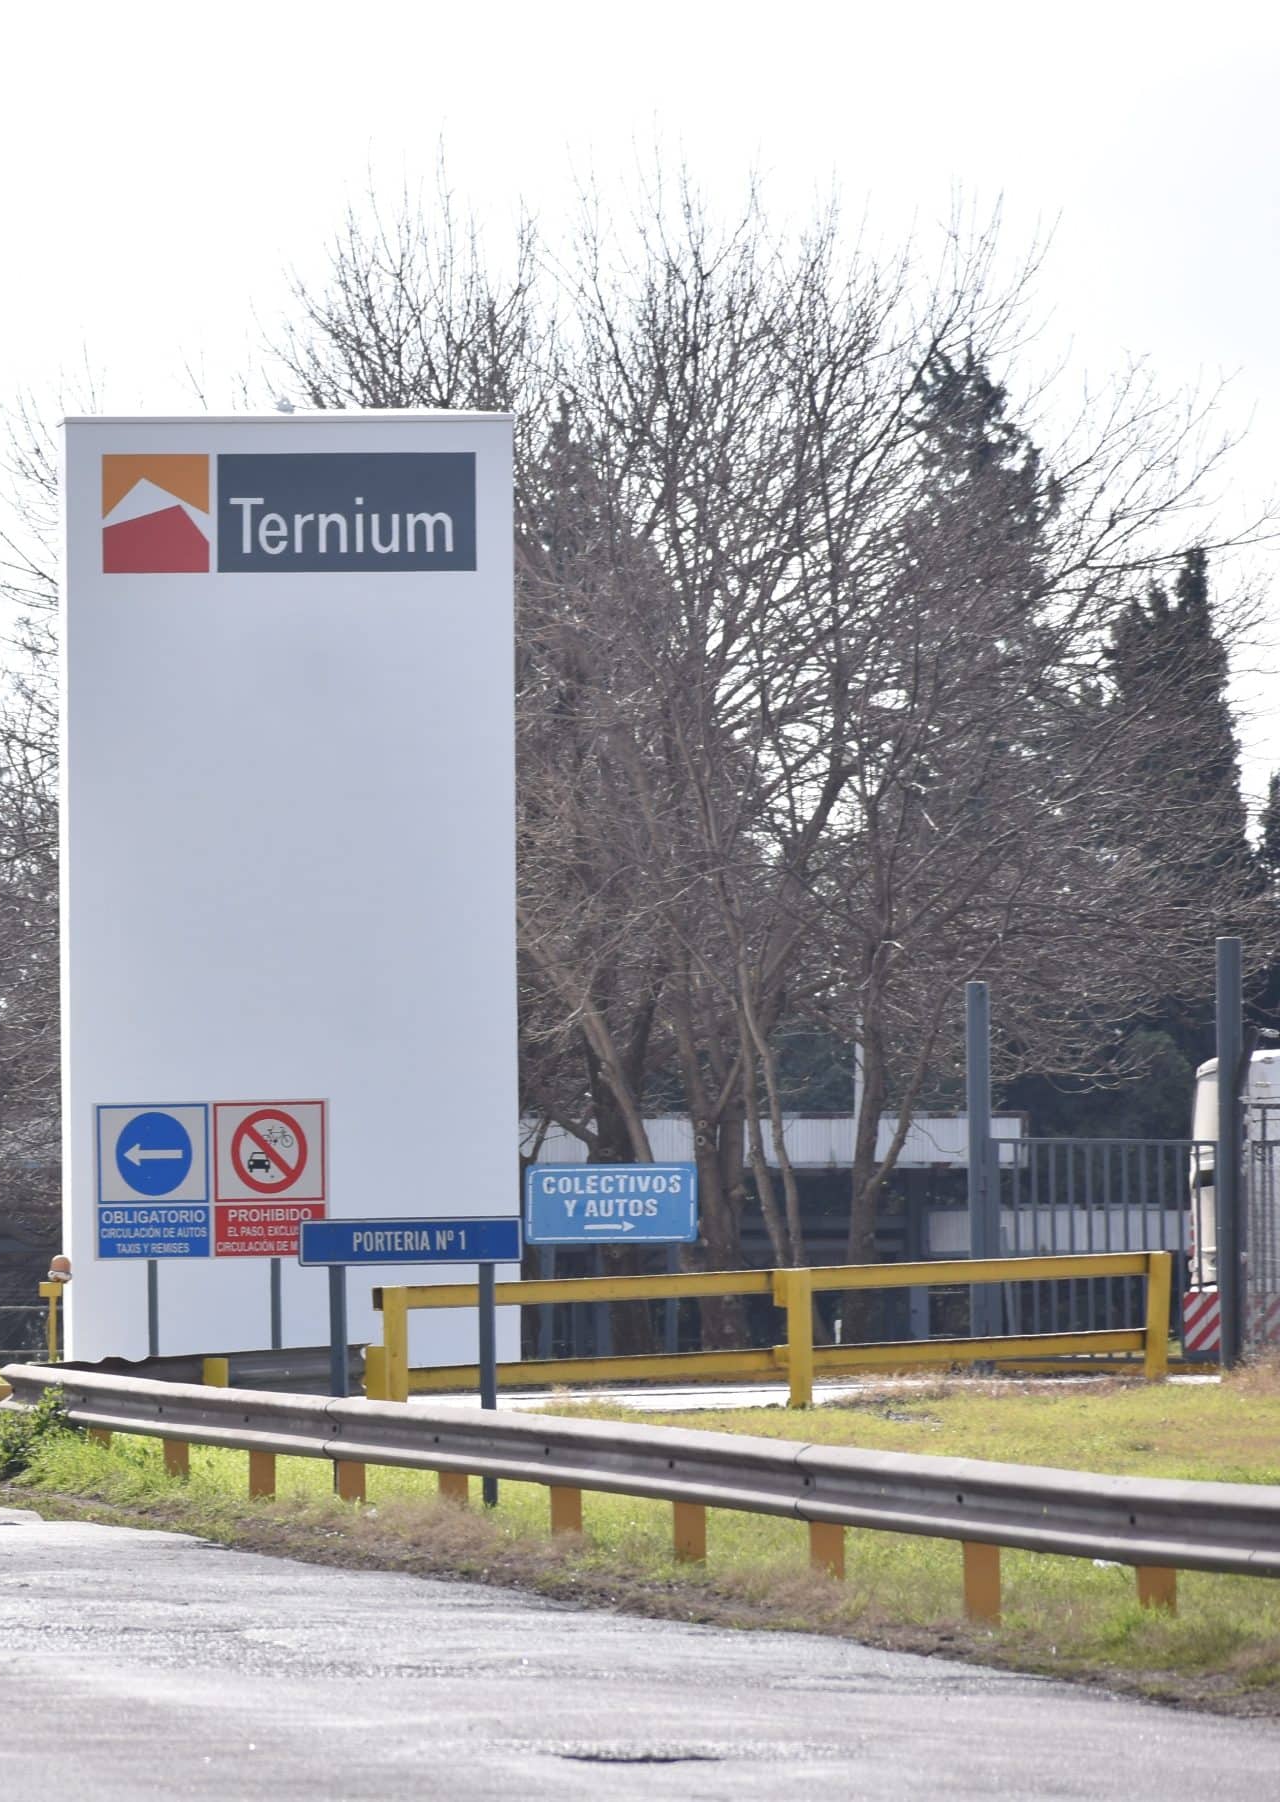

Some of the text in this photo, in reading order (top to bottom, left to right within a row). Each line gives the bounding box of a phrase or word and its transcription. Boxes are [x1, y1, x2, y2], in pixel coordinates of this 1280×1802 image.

[229, 496, 454, 555] Ternium
[542, 1174, 682, 1195] COLECTIVOS
[564, 1198, 659, 1217] Y AUTOS
[101, 1209, 206, 1224] OBLIGATORIO
[228, 1208, 312, 1222] PROHIBIDO
[101, 1225, 207, 1239] CIRCULACIÓN DE AUTOS
[227, 1226, 239, 1237] EL
[115, 1242, 190, 1254] TAXIS Y REMISES
[216, 1239, 275, 1252] CIRCULACIÓN
[277, 1240, 289, 1251] DE
[353, 1230, 431, 1252] PORTERIA
[458, 1230, 467, 1250] 1
